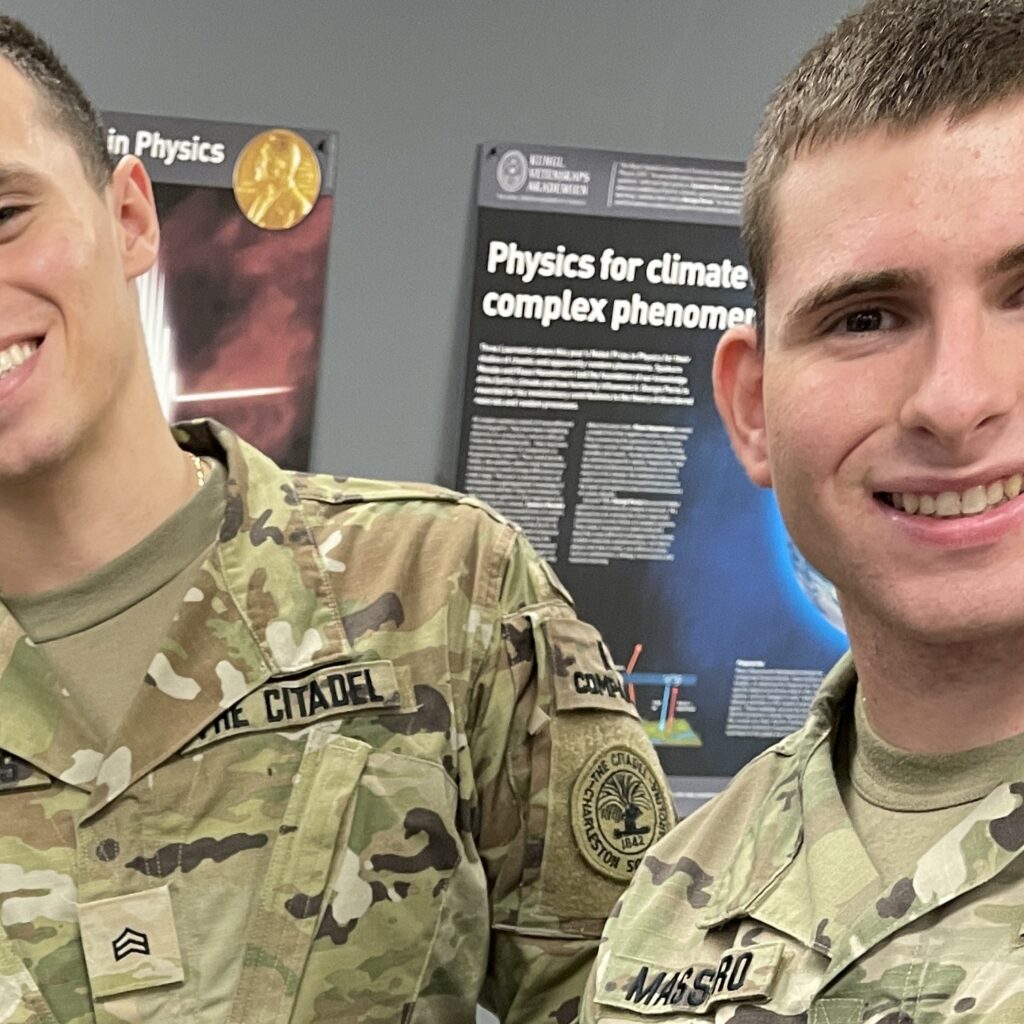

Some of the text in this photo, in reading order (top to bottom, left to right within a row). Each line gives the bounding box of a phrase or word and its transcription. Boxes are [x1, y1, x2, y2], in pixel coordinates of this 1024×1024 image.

[107, 128, 225, 165] in Physics
[487, 240, 749, 289] Physics for climate
[482, 289, 608, 327] complex
[198, 669, 384, 740] HE CITADEL
[591, 760, 610, 783] THE
[581, 789, 620, 869] CHARLESTON
